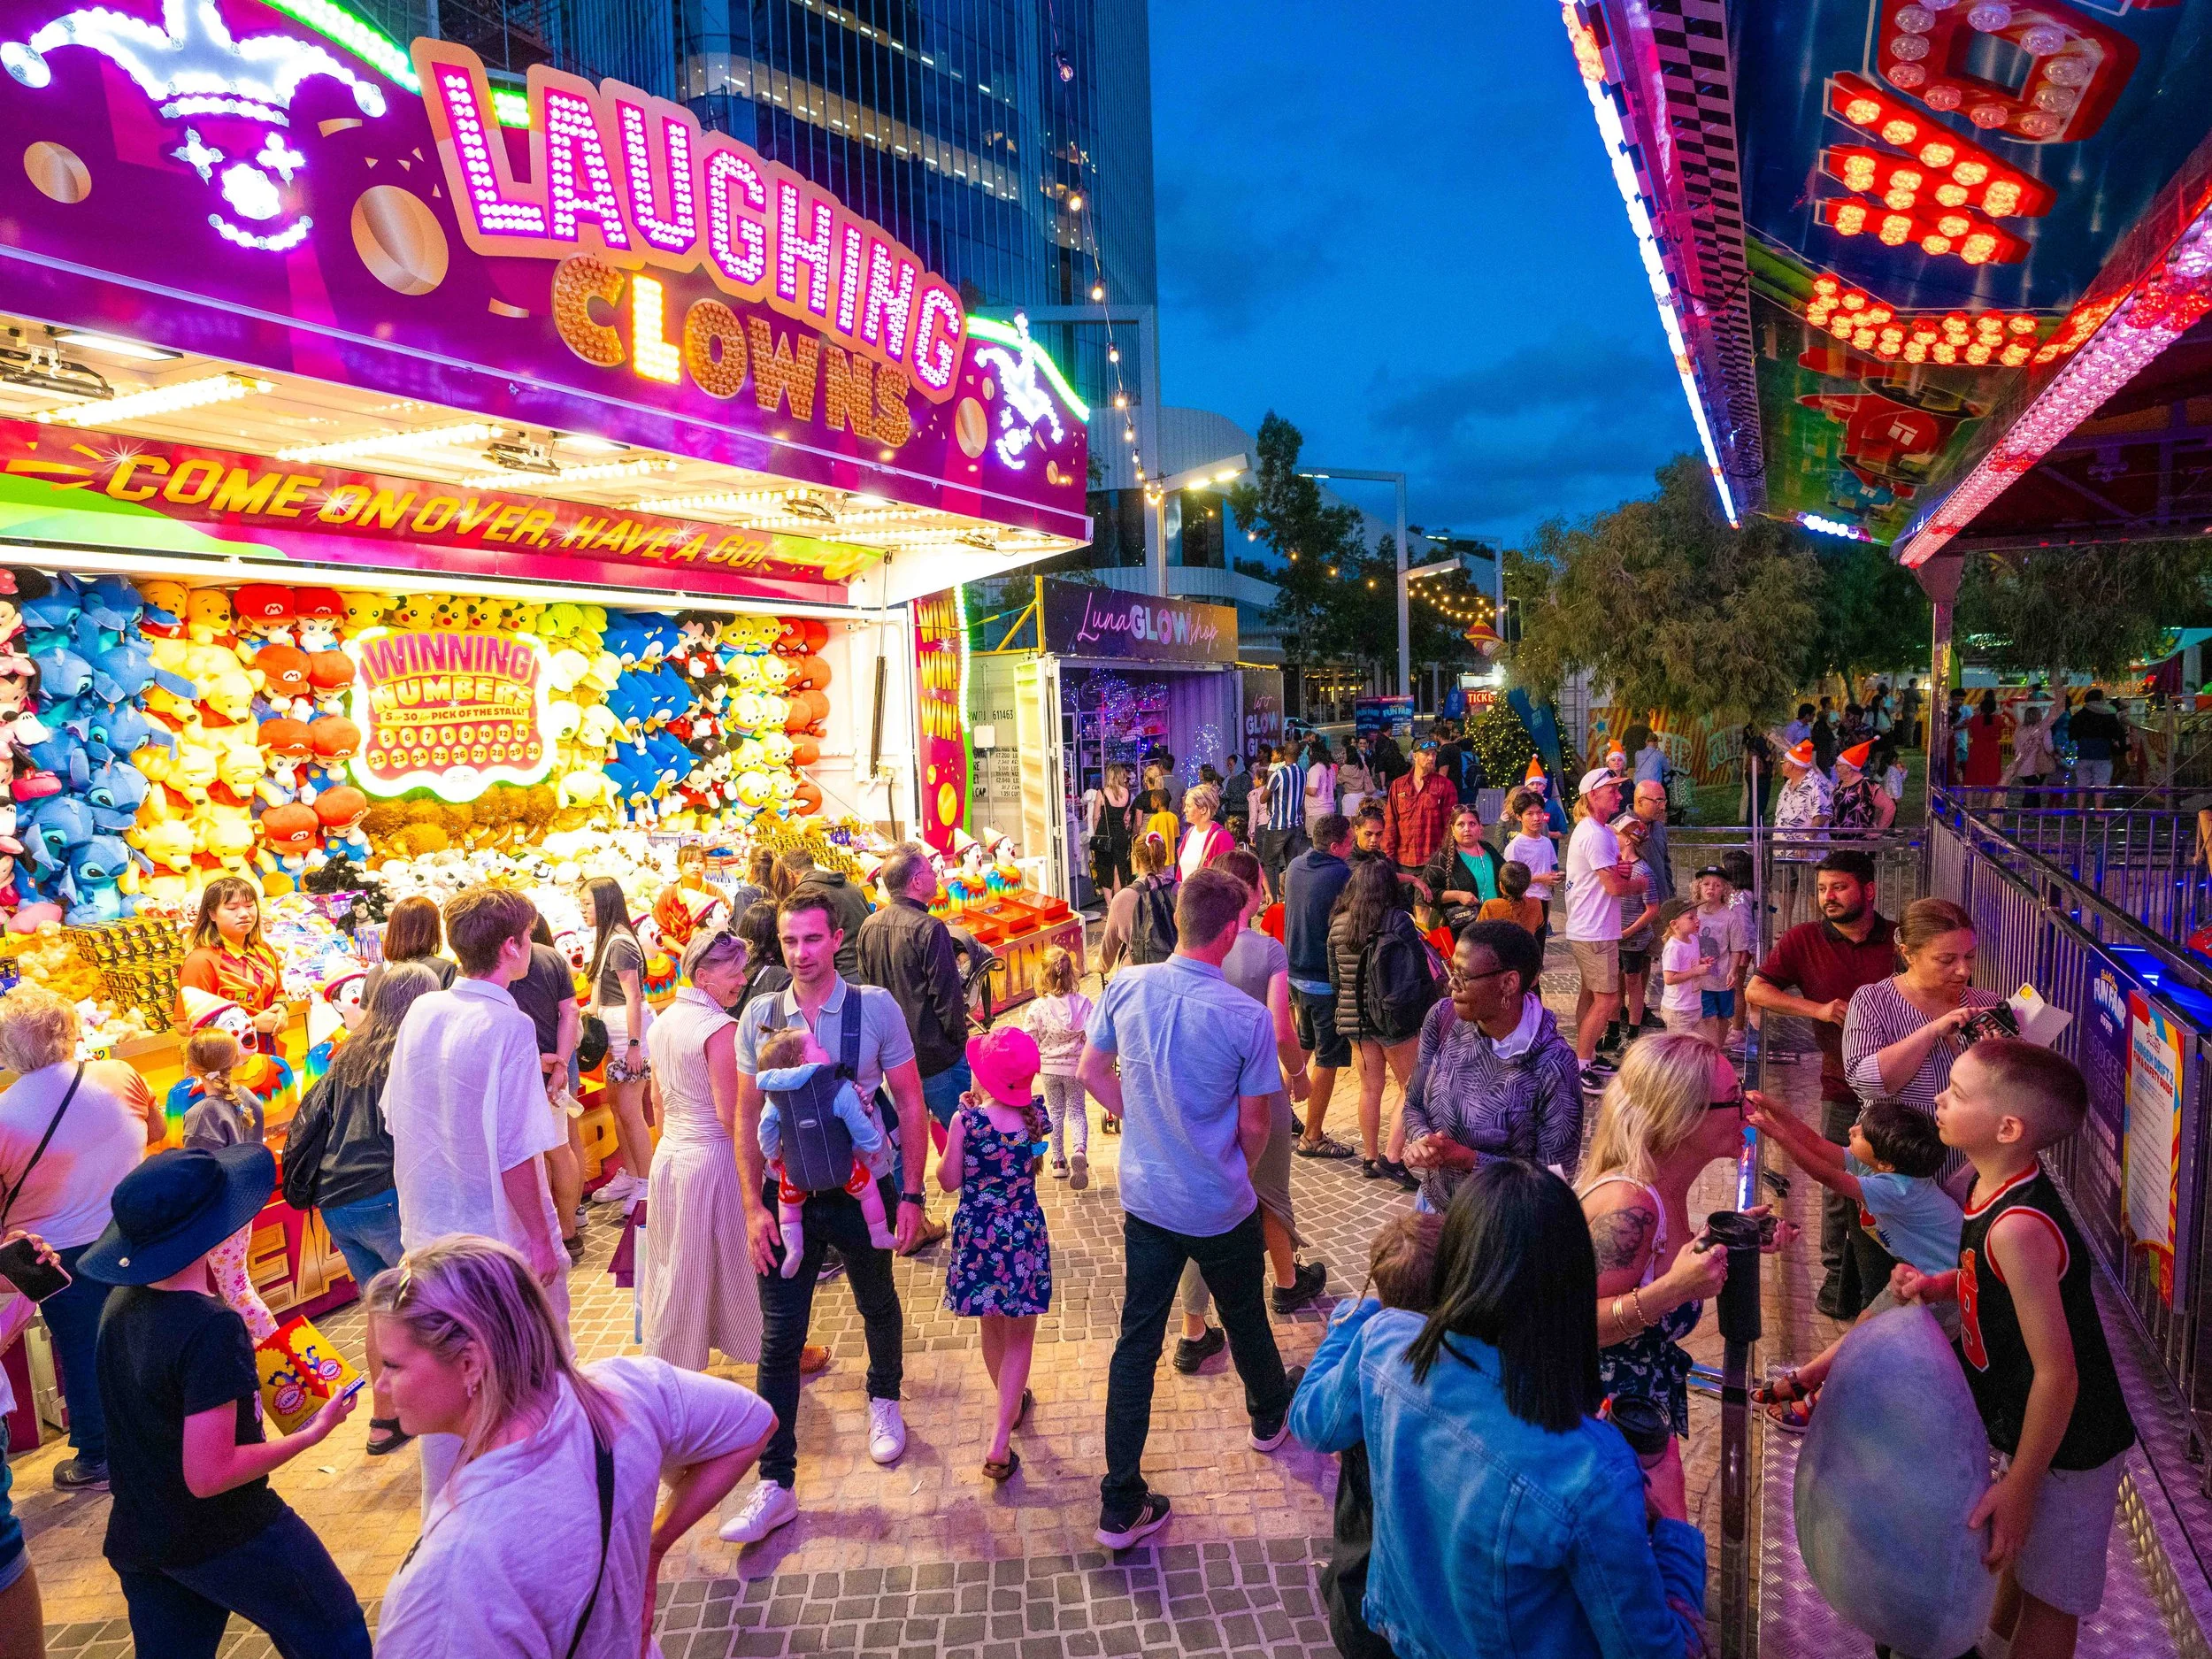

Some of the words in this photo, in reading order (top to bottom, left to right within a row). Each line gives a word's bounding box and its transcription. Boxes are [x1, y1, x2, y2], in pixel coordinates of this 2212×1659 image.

[430, 58, 963, 391] LAUGHING
[551, 253, 911, 449] CLOWNS
[105, 454, 324, 518] COME
[318, 484, 416, 529] ON
[411, 495, 557, 548] OVER,
[560, 515, 680, 558] HAVE
[671, 532, 709, 563] A
[708, 534, 769, 570] GO!
[917, 600, 957, 644] WIN!
[1077, 592, 1132, 642] Luna
[1130, 604, 1191, 645] GLOW
[1189, 613, 1218, 655] shop
[362, 632, 533, 682] WINNING
[919, 650, 957, 690] WIN!
[369, 675, 534, 714] NUMBERS
[403, 712, 418, 721] 30
[431, 711, 457, 720] PICK
[494, 707, 525, 716] STALL!
[1383, 707, 1398, 718] FUN
[1397, 707, 1412, 717] FAIR
[1468, 693, 1493, 703] TICKE
[920, 696, 958, 741] WIN!
[993, 710, 1014, 720] 611463
[370, 755, 384, 764] 22
[392, 754, 405, 764] 23
[412, 753, 426, 763] 24
[510, 748, 521, 757] 29
[281, 1393, 298, 1407] LARGE
